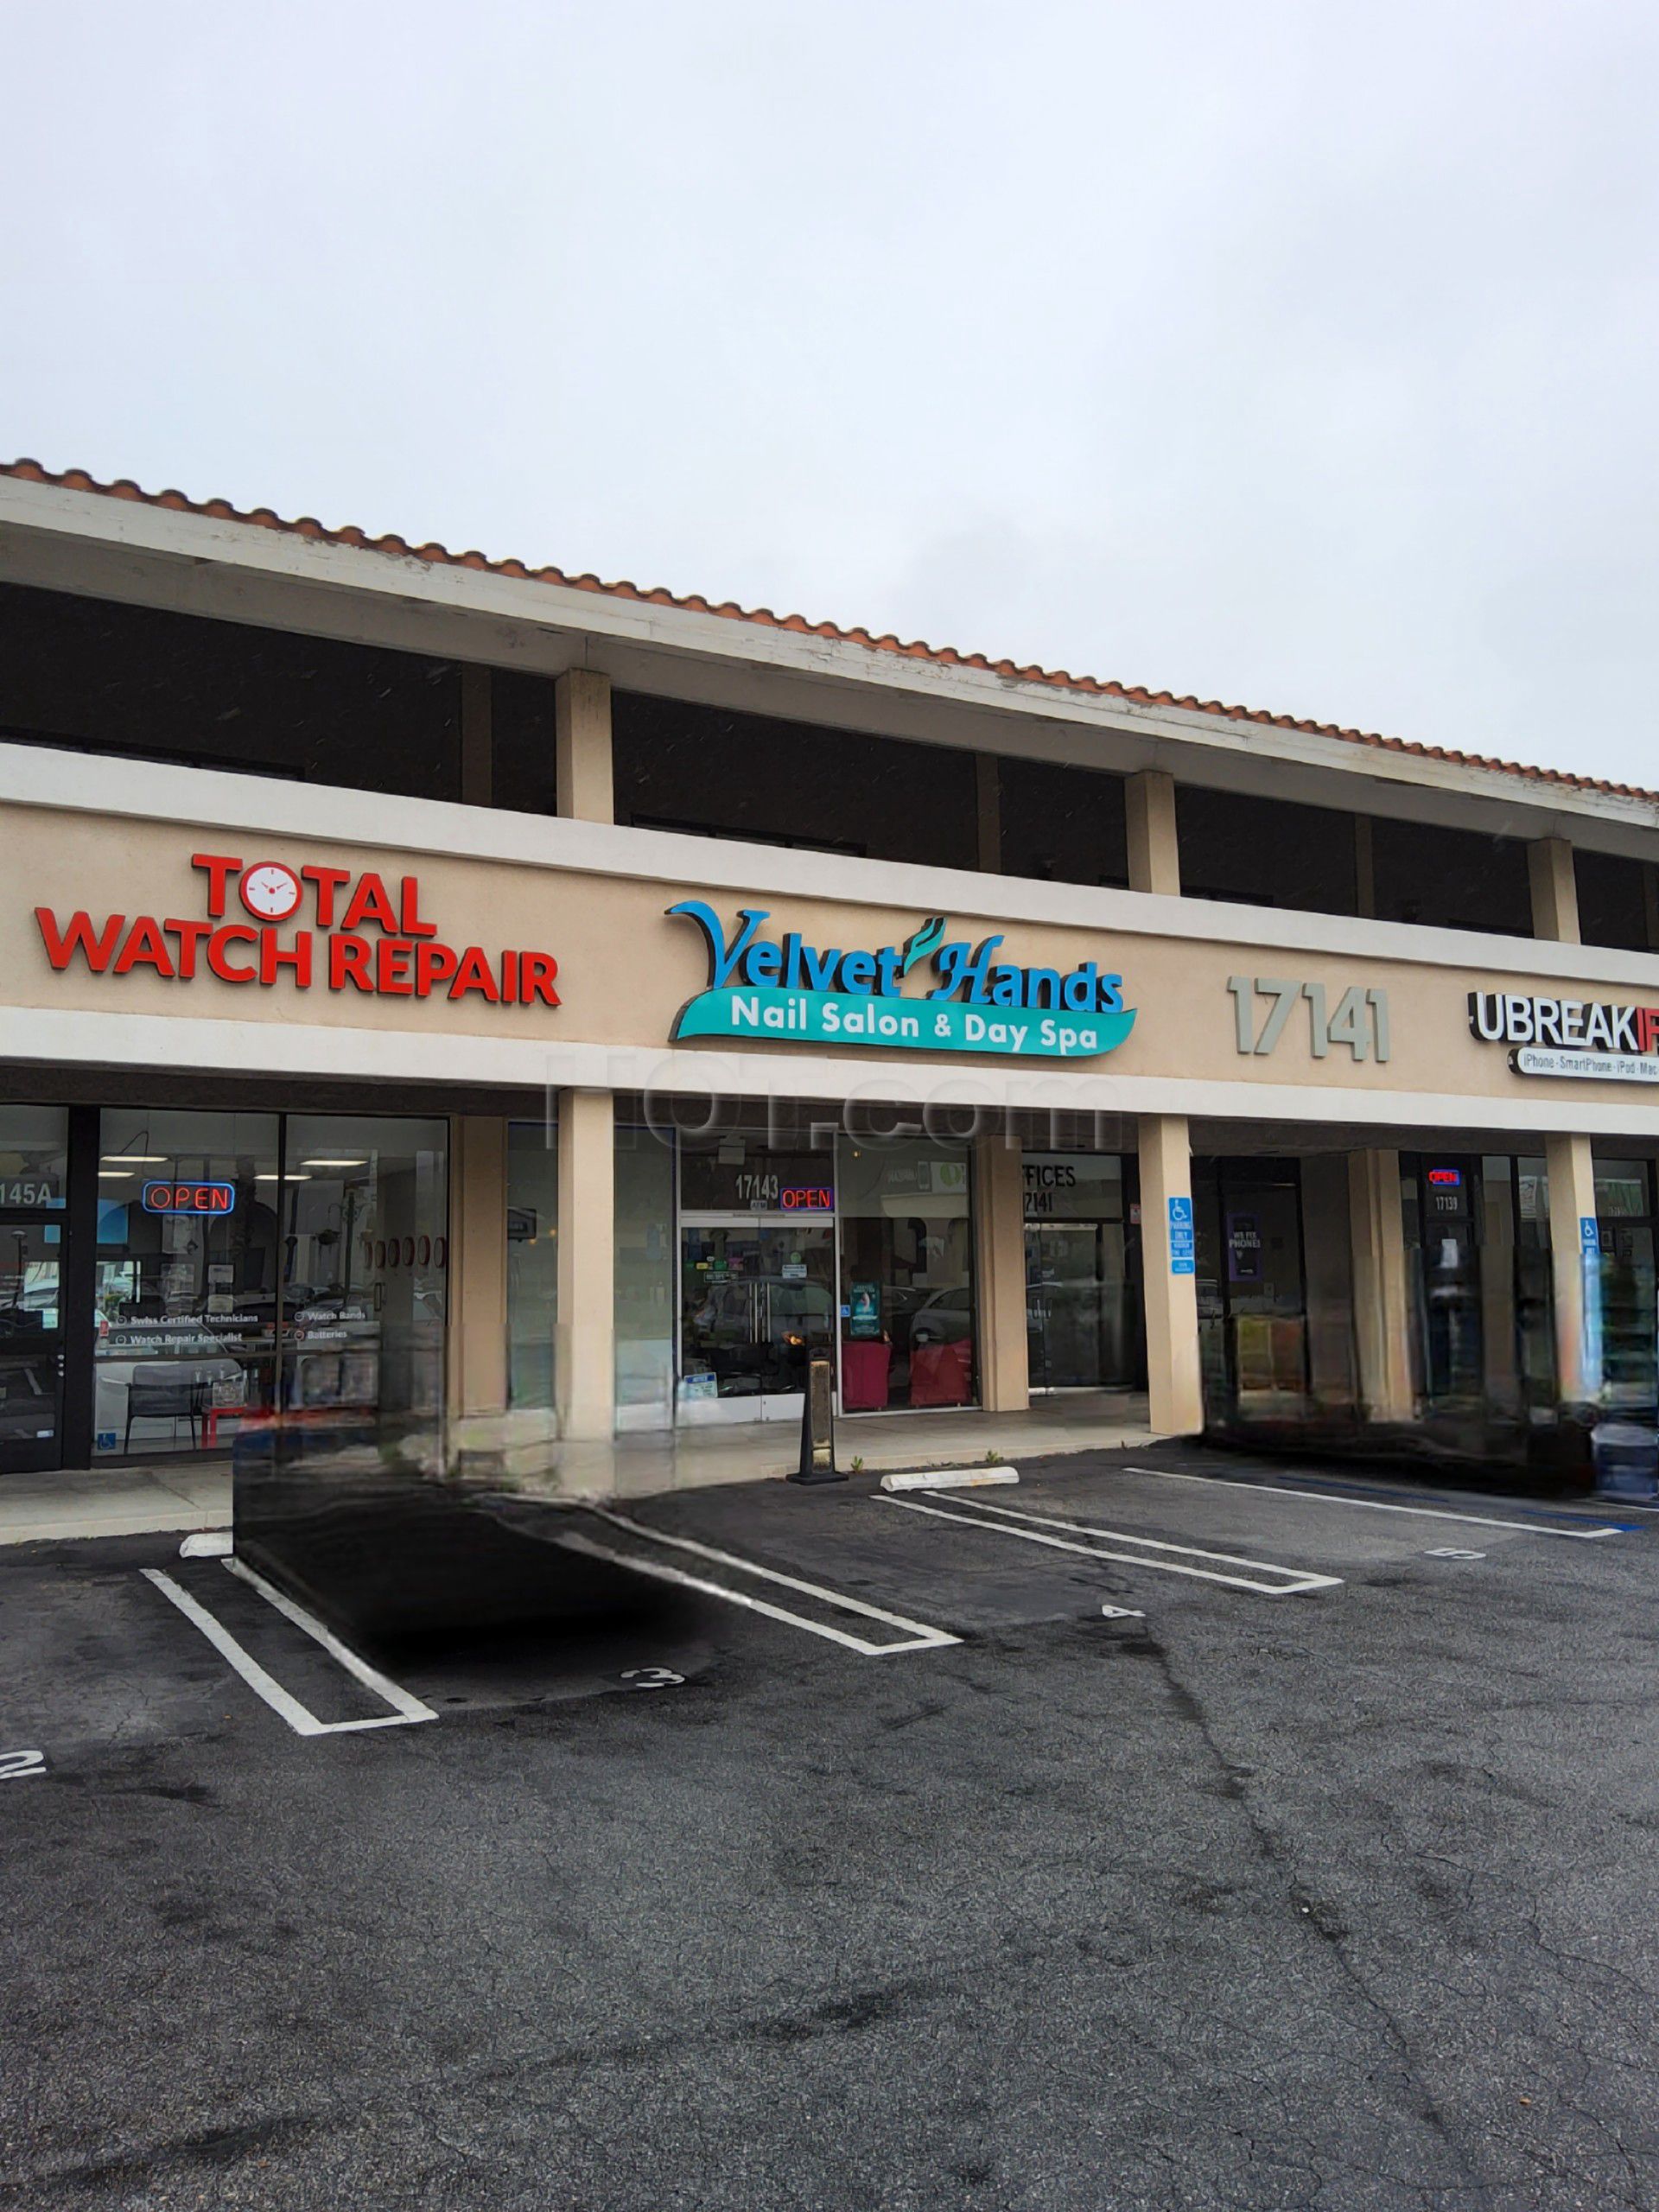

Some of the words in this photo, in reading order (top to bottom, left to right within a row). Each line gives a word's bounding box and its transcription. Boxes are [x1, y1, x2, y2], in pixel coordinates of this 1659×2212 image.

[192, 853, 437, 937] TOTAL
[34, 907, 313, 988] WATCH
[329, 933, 562, 1007] REPAIR
[664, 900, 902, 996] Velvet
[927, 935, 1124, 1014] Hands
[732, 995, 807, 1031] Nail
[822, 1002, 918, 1037] Salon
[934, 1013, 951, 1037] &
[965, 1014, 1028, 1052] Day
[1040, 1020, 1097, 1055] Spa
[1227, 976, 1389, 1062] 17141
[1523, 1053, 1554, 1069] iPhone
[1560, 1056, 1612, 1072] SmartPhone
[1618, 1060, 1637, 1074] iPod
[735, 1174, 779, 1200] 17143
[149, 1186, 228, 1211] OPEN
[782, 1189, 830, 1208] OPEN
[130, 1316, 158, 1325] Swiss
[160, 1314, 203, 1325] Certified
[204, 1313, 258, 1324] Technicians
[308, 1311, 337, 1321] Watch
[339, 1311, 365, 1320] Bands
[130, 1334, 162, 1344] Watch
[164, 1333, 195, 1345] Repair
[198, 1332, 243, 1344] Specialist
[308, 1331, 347, 1339] Batteries
[1423, 1548, 1486, 1559] 5
[1102, 1605, 1146, 1618] 4
[620, 1668, 685, 1687] 3
